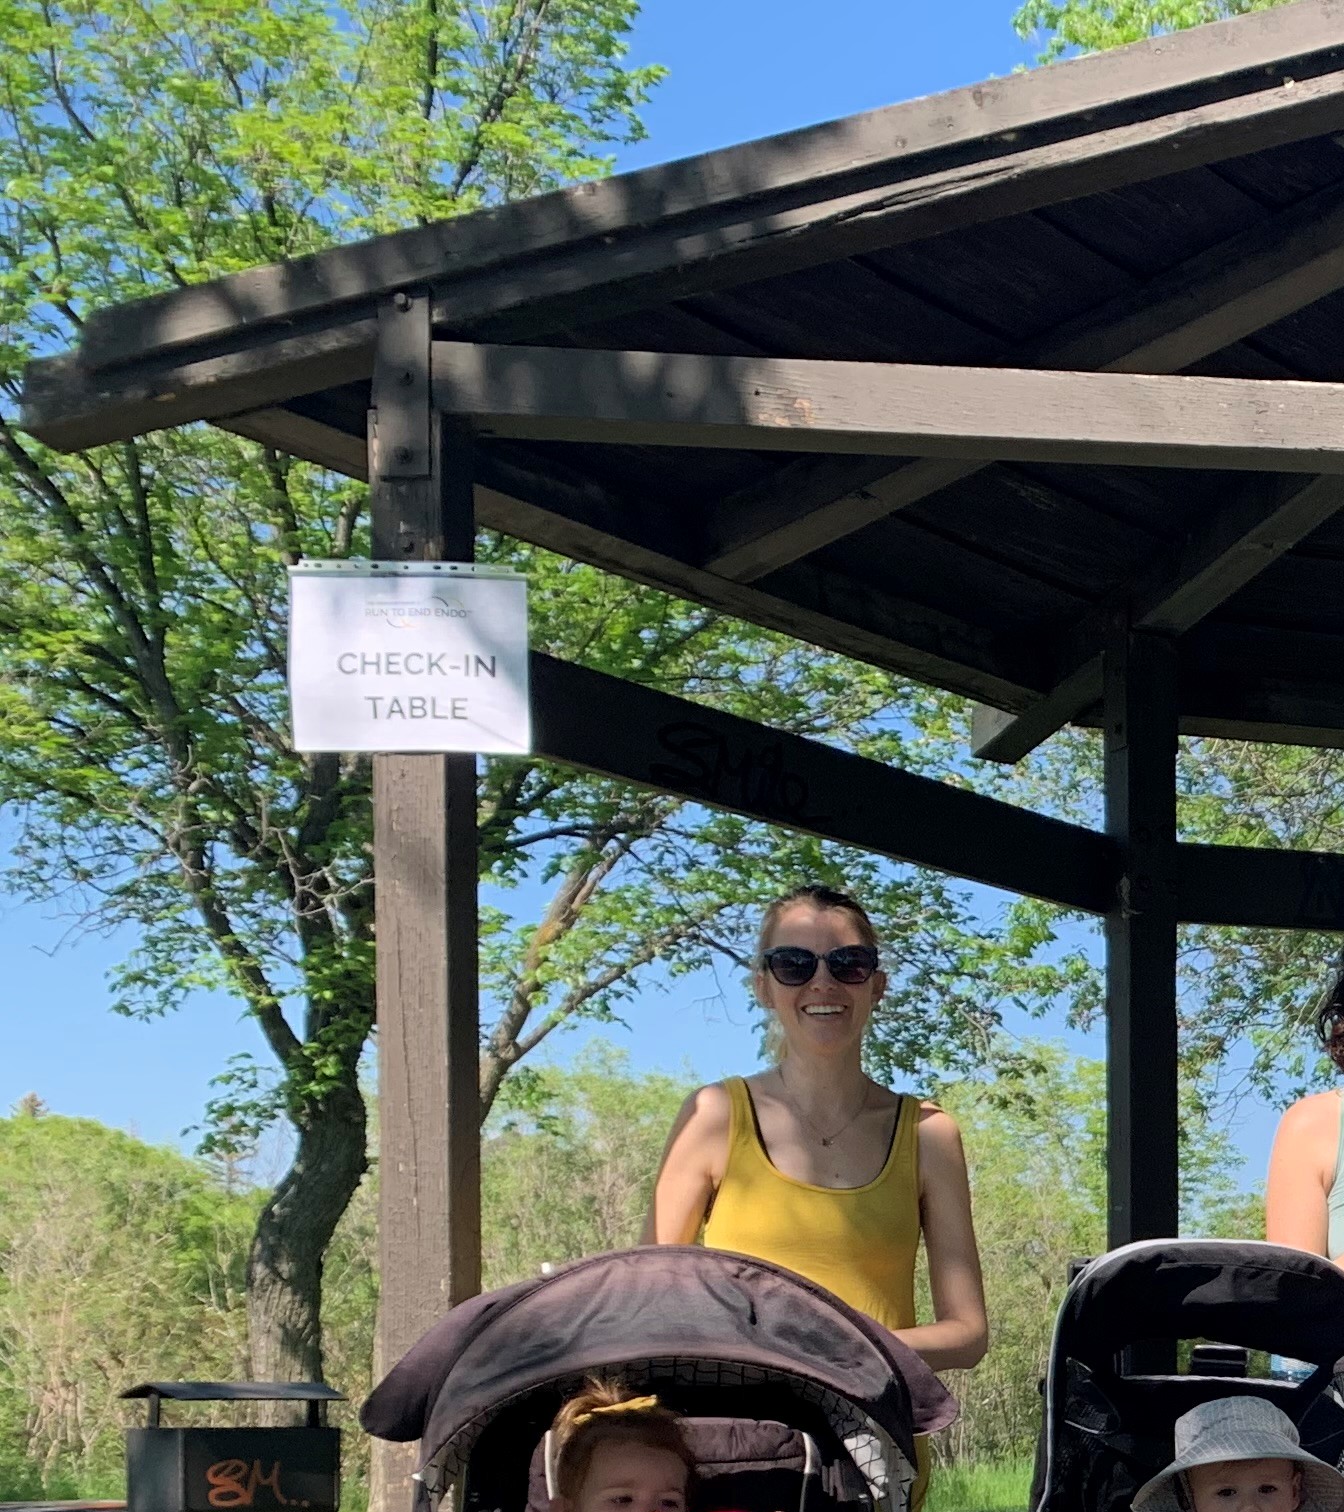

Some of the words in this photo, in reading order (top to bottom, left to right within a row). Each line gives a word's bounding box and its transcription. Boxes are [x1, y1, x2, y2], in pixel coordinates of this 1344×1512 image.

[364, 607, 388, 617] RUN
[392, 607, 405, 617] TO
[408, 607, 431, 617] END
[337, 652, 497, 678] CHECK-IN
[364, 696, 469, 720] TABLE
